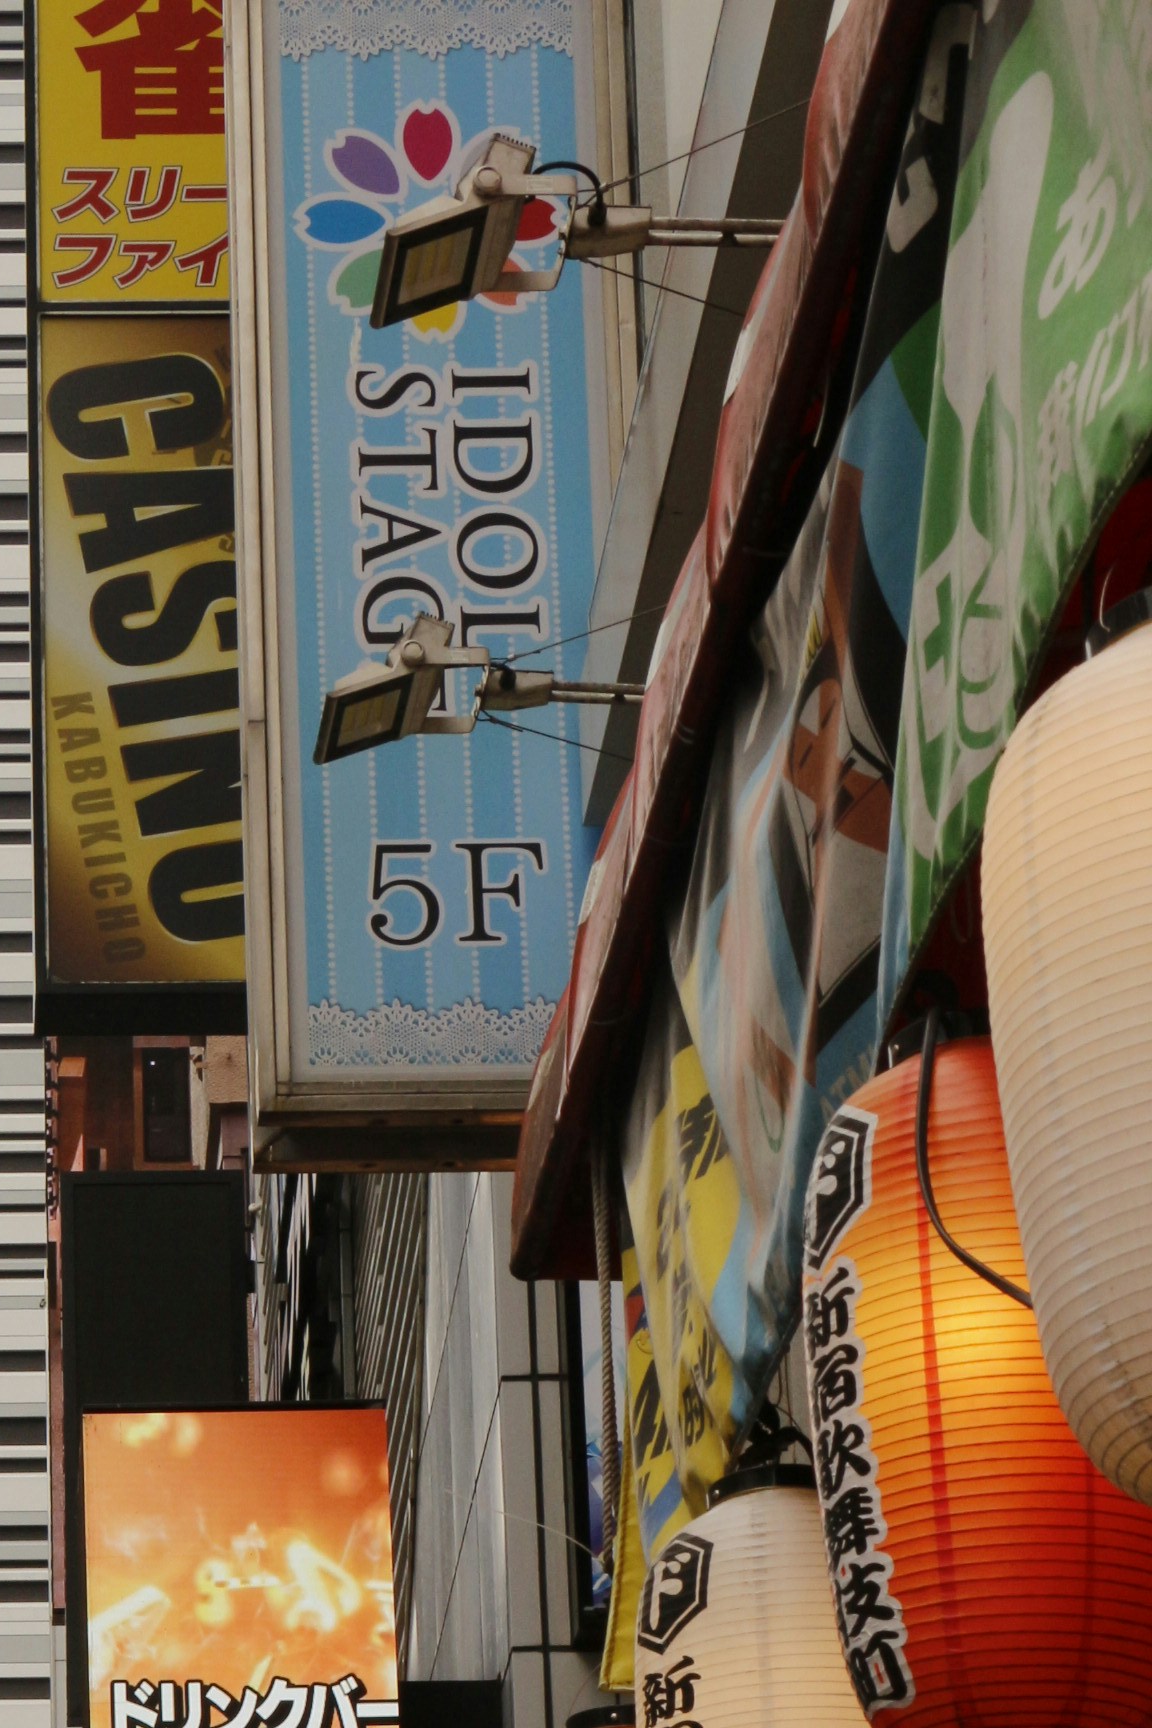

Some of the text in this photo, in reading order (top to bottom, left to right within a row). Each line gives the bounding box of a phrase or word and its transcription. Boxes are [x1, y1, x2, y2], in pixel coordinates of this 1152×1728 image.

[354, 370, 448, 718] STAG
[451, 366, 541, 646] IDOL
[48, 354, 244, 943] CASINO
[50, 692, 146, 964] KABUKICHO
[369, 842, 545, 946] 5F
